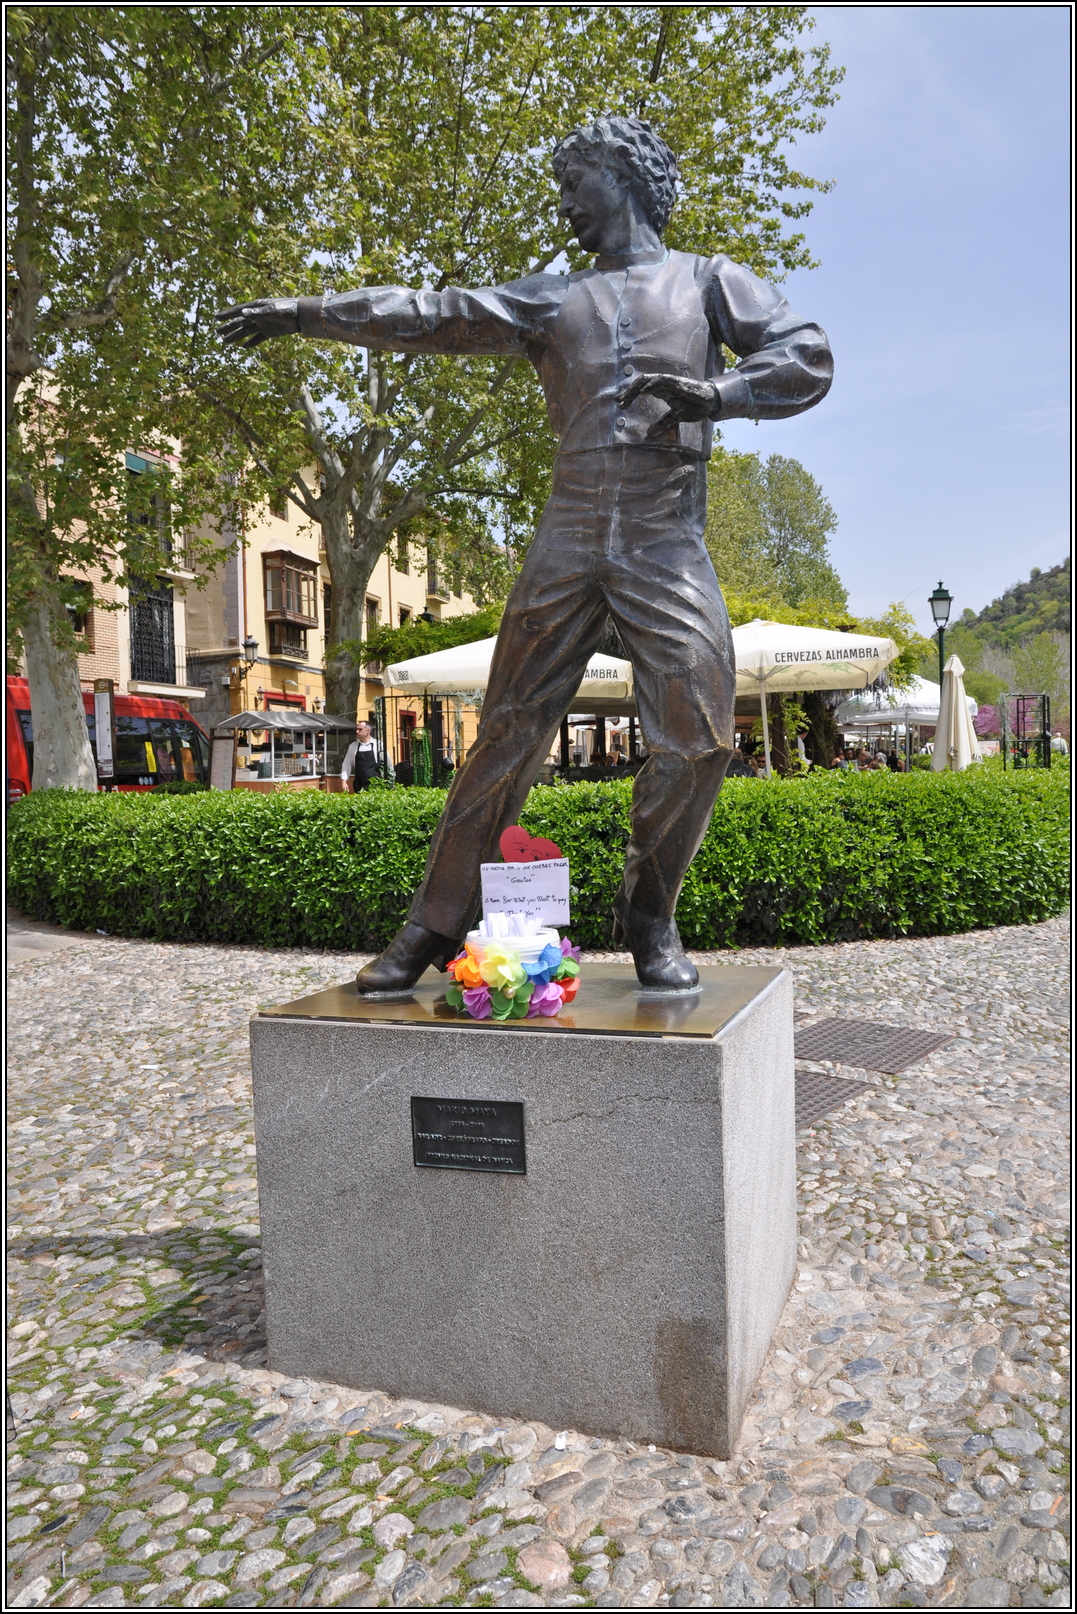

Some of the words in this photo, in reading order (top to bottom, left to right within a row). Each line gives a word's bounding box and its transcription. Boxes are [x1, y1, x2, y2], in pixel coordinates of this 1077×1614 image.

[775, 650, 822, 663] CERVEZAS
[826, 647, 879, 661] ALHAMBRA
[584, 669, 618, 679] AMBRA
[436, 1104, 467, 1114] MARIO
[470, 1106, 497, 1117] MAYA
